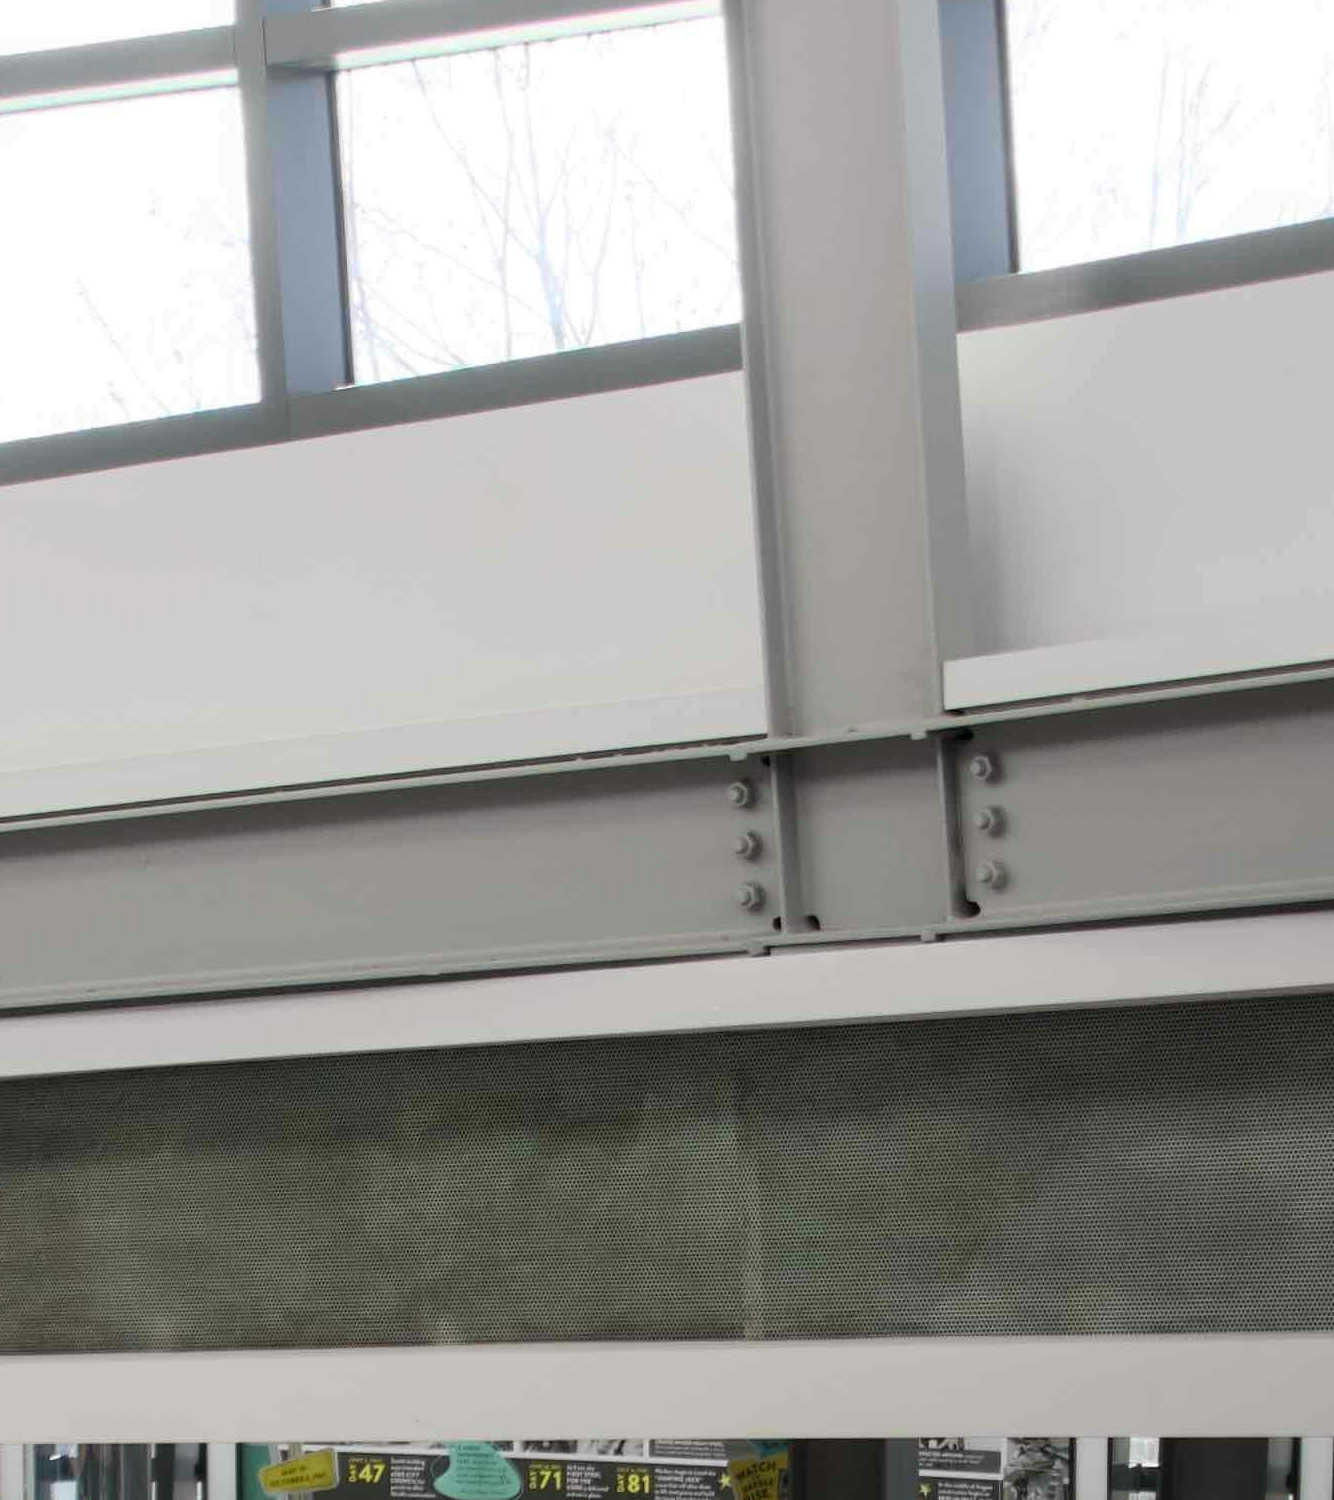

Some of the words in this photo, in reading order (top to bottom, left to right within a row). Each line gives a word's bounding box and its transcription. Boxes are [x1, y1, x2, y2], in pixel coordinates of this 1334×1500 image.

[348, 1461, 357, 1483] DAY
[358, 1463, 386, 1483] 47
[529, 1471, 537, 1490] DAY
[539, 1470, 562, 1490] 71
[616, 1474, 625, 1493] DAY
[627, 1474, 650, 1494] 81
